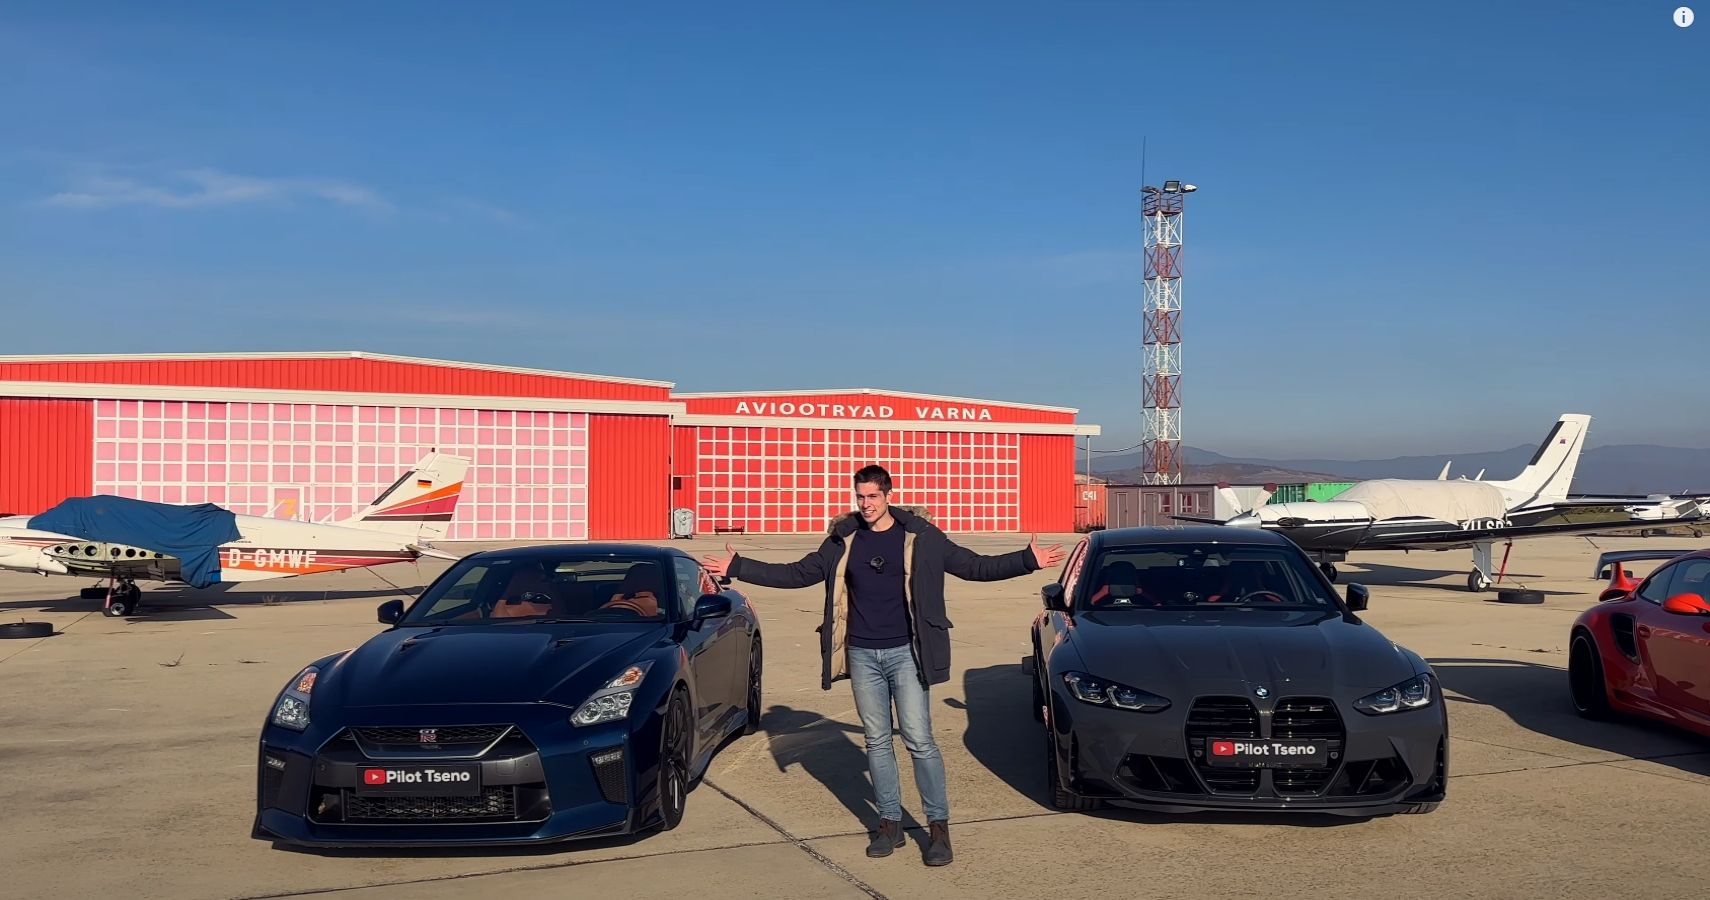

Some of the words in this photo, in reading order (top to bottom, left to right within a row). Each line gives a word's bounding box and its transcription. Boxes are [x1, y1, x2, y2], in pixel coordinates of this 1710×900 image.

[735, 401, 894, 418] AVIOOTRYAD
[915, 406, 992, 420] VARNA
[228, 548, 317, 569] D-GMWF
[1234, 743, 1269, 755] Pilot
[1271, 743, 1316, 755] Tseno
[386, 770, 422, 783] Pilot
[424, 769, 470, 782] Tseno
